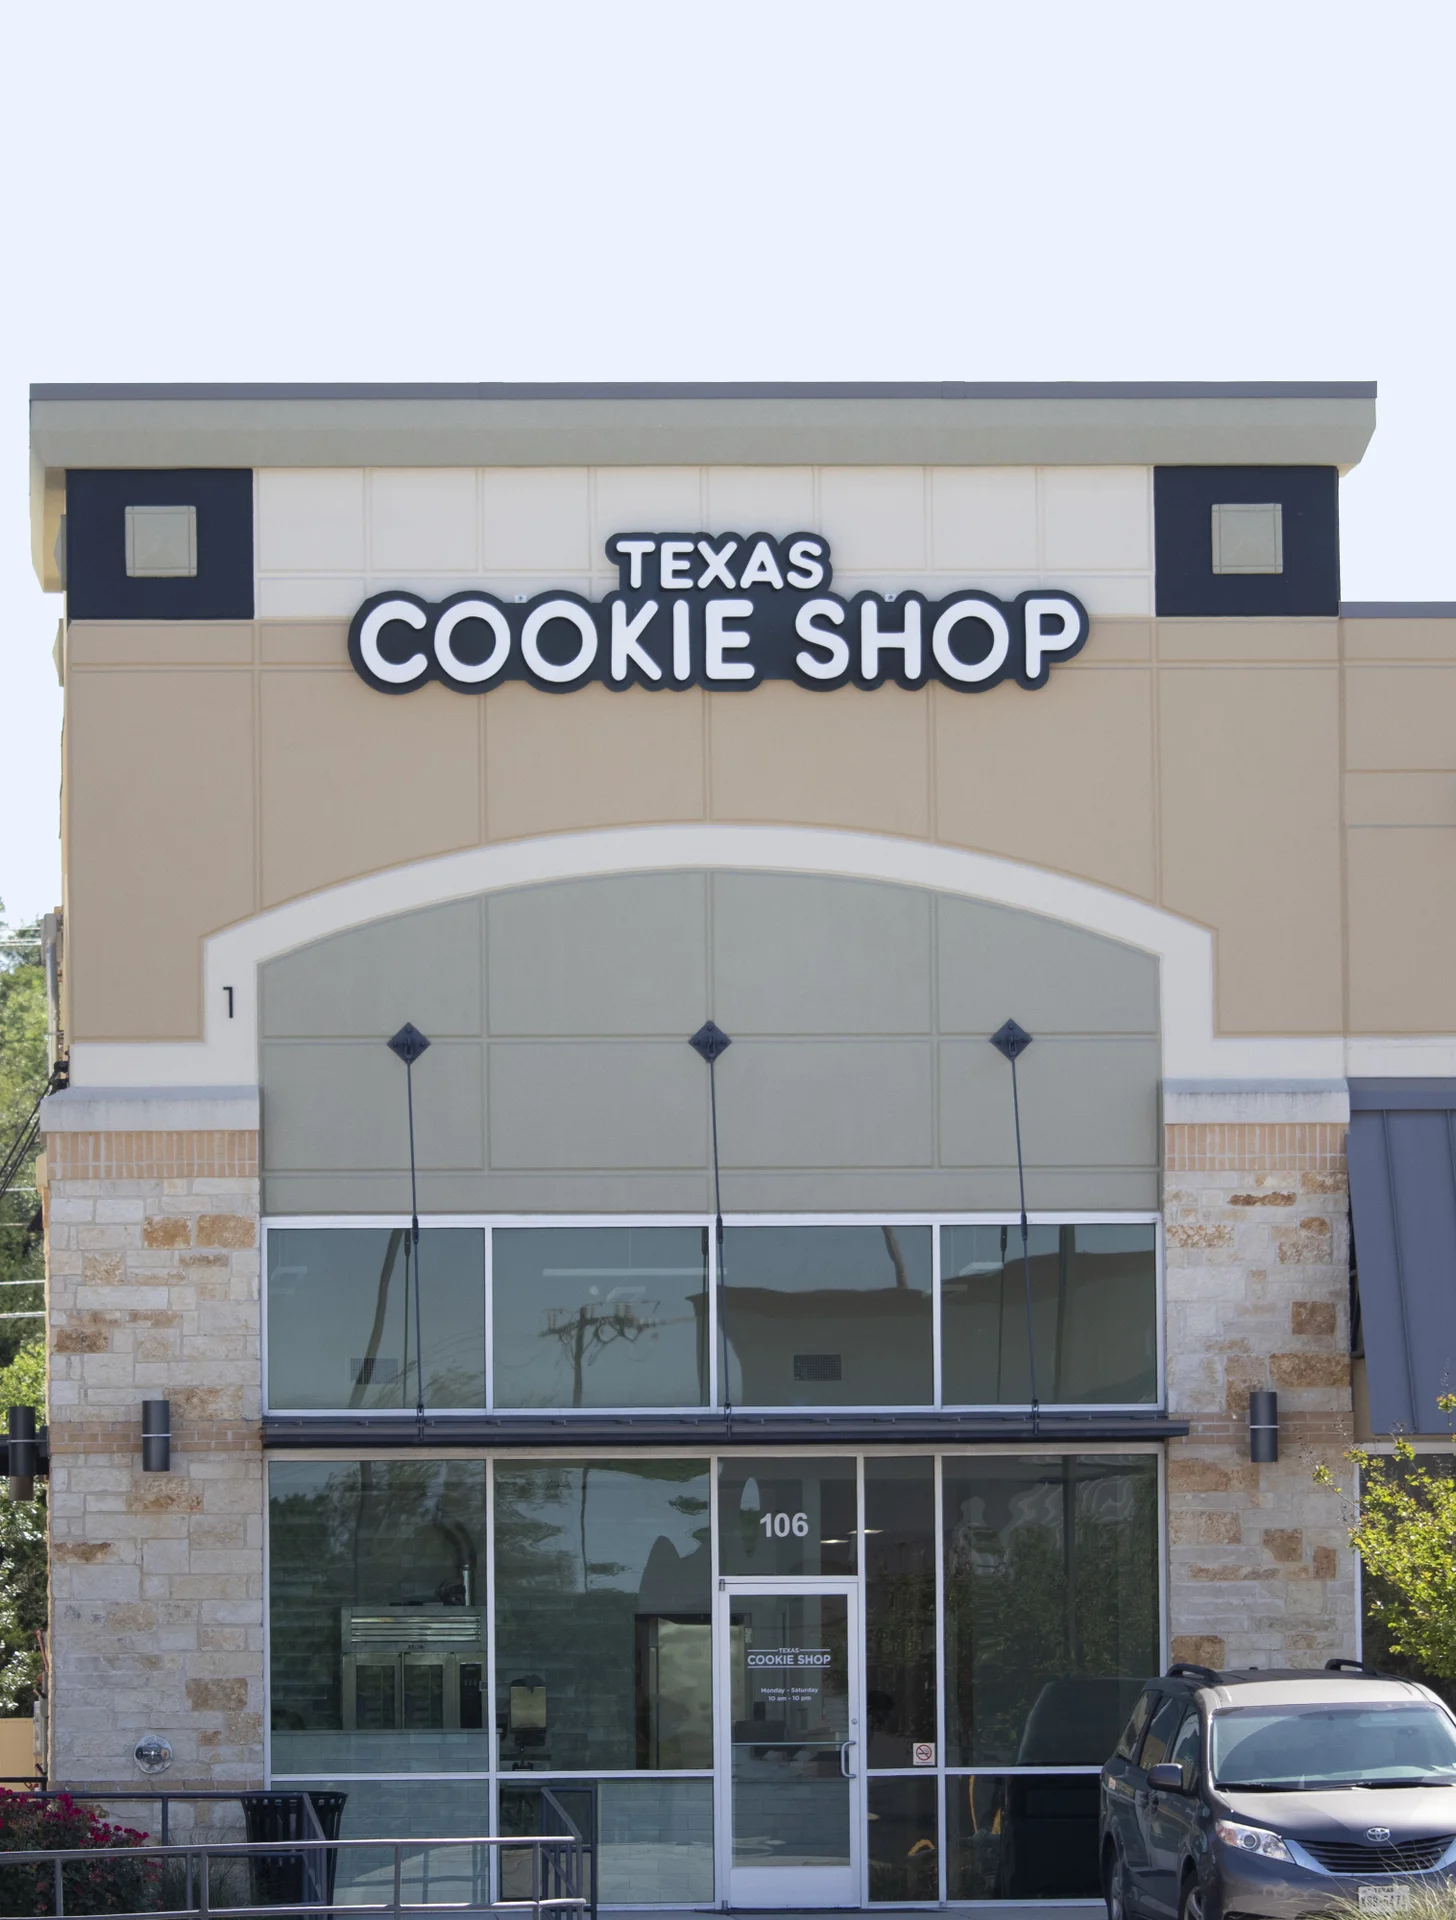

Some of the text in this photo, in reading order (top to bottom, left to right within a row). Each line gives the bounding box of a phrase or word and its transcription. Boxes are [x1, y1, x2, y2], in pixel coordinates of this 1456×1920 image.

[616, 540, 824, 589] TEXAS
[360, 599, 1081, 683] COOKIE SHOP
[222, 986, 234, 1019] 1
[760, 1512, 809, 1538] 106
[747, 1654, 831, 1665] COOKIE SHOP
